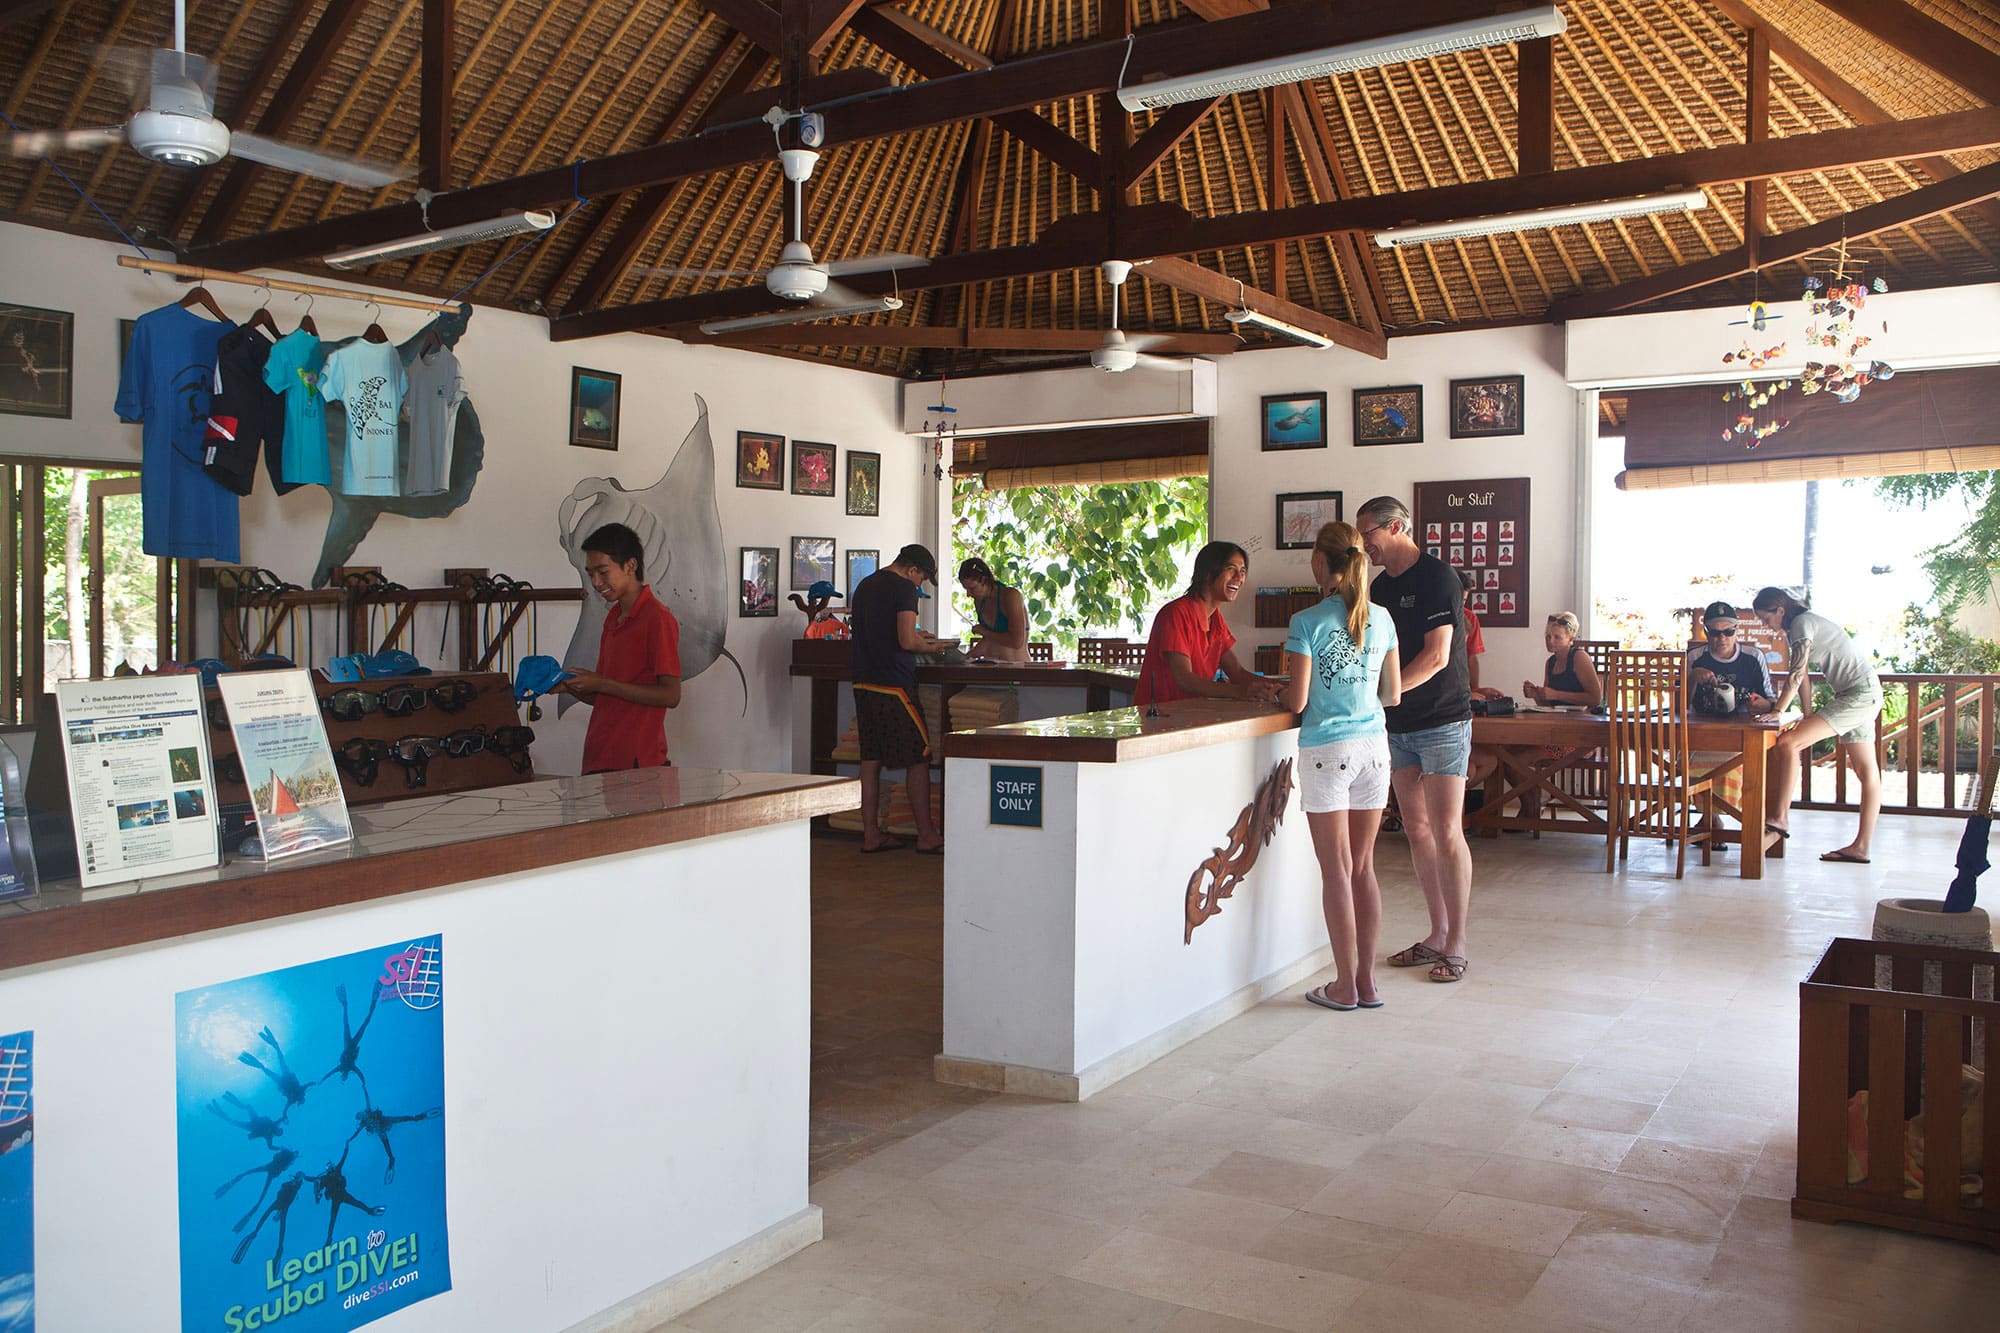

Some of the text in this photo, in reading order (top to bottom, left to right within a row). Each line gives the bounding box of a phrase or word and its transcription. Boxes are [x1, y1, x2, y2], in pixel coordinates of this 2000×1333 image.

[1447, 491, 1496, 507] Our Staff
[996, 781, 1036, 794] STAFF
[999, 797, 1033, 811] ONLY
[379, 948, 425, 986] SSI
[266, 1229, 386, 1290] Learn to
[224, 1232, 419, 1333] Scuba DIVE!
[343, 1269, 419, 1310] diveSSI.com
